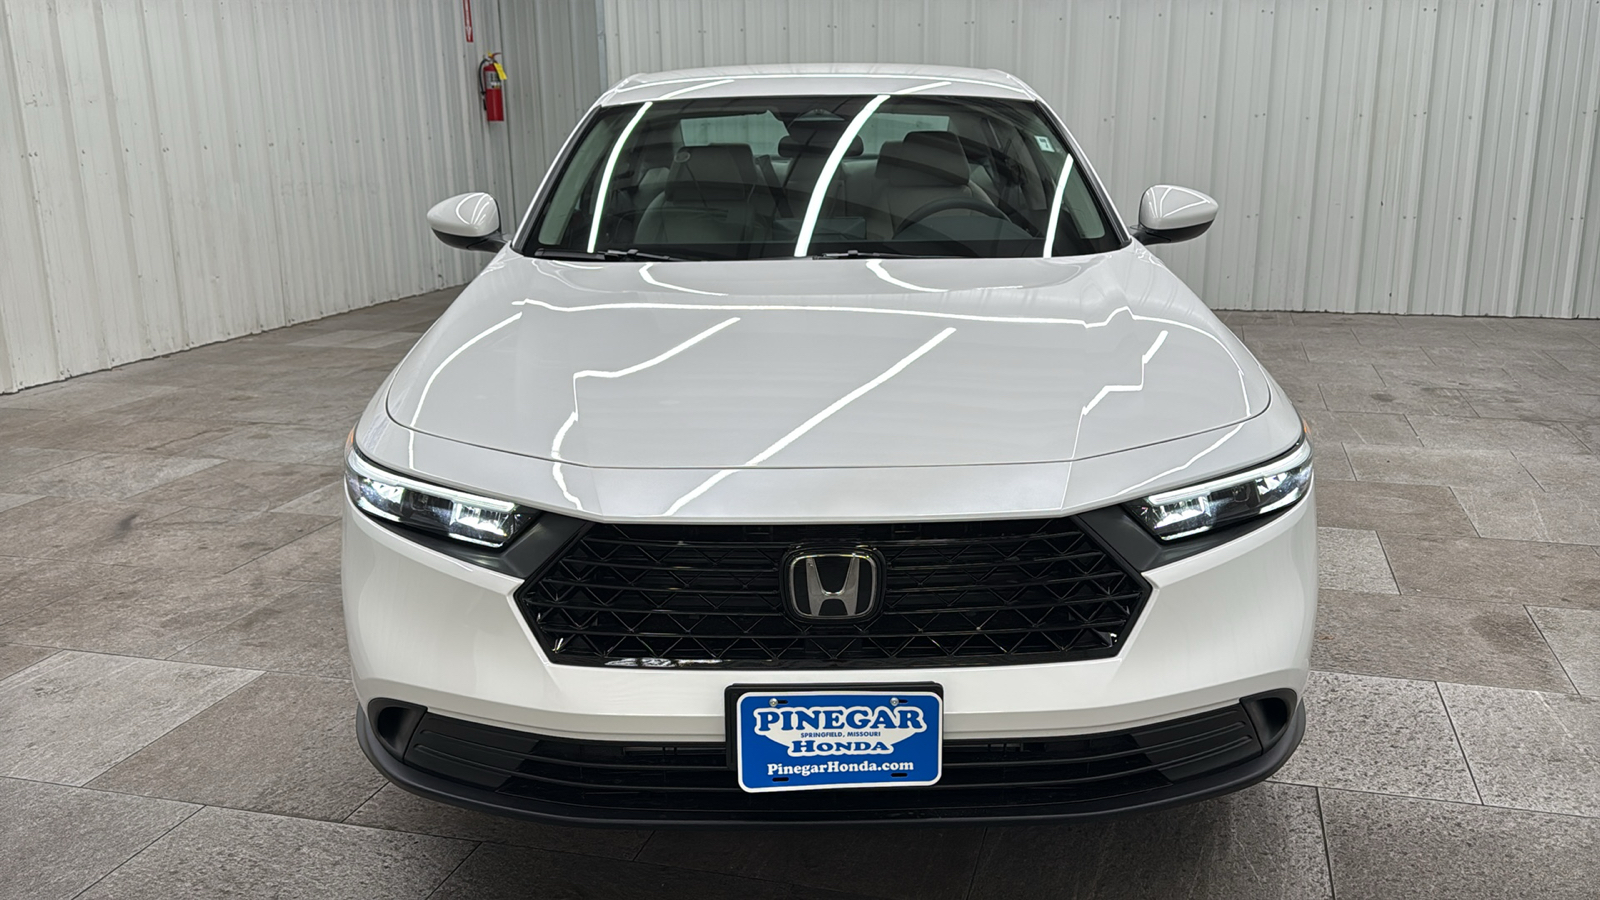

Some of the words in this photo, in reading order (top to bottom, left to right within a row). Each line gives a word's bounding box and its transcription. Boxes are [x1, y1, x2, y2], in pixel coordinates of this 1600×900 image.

[757, 709, 923, 731] PINEGAR
[791, 740, 890, 753] HONDA
[767, 761, 914, 776] PinegarHonda.com
